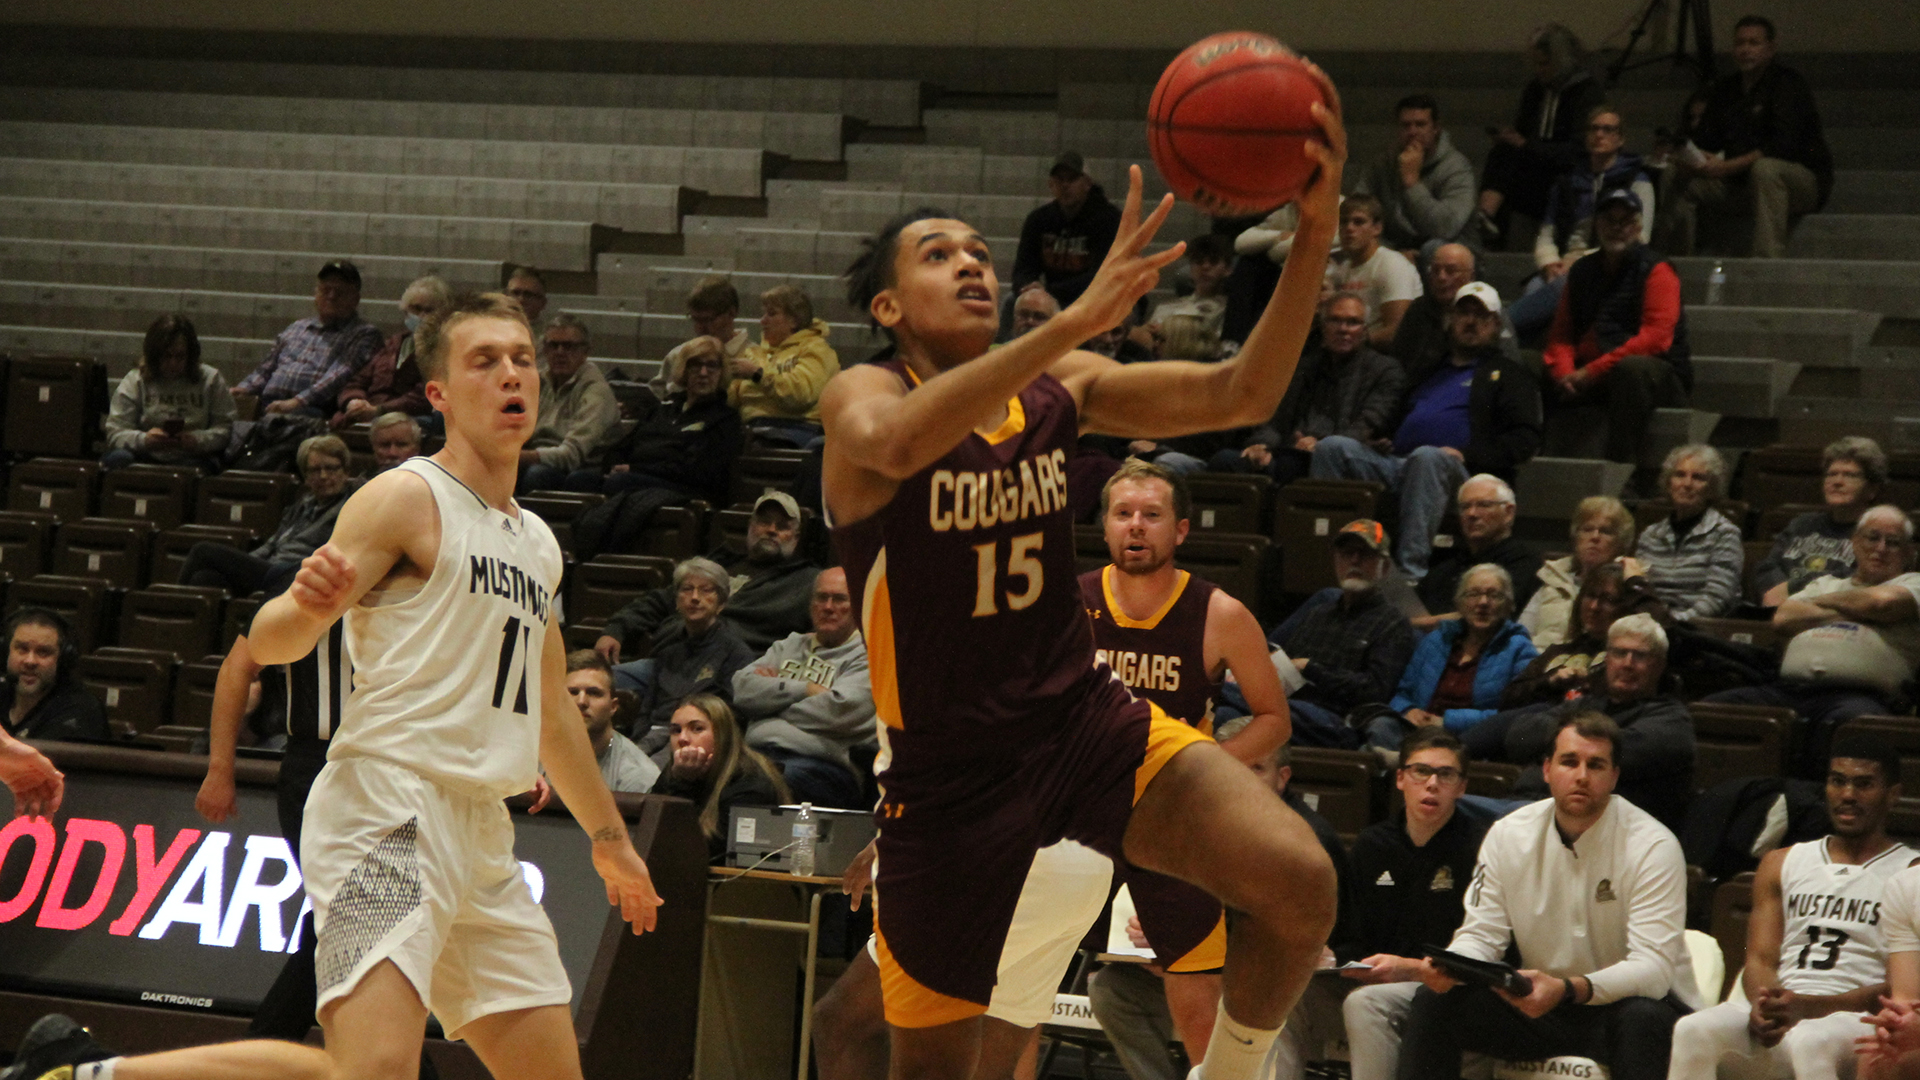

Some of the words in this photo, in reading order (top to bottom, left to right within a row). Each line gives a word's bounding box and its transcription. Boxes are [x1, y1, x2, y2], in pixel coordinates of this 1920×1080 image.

[929, 448, 1067, 532] COUGARS
[971, 531, 1044, 618] 15
[491, 615, 531, 716] 11
[1093, 648, 1182, 692] UGARS
[1787, 893, 1882, 926] MUSTANGS
[1797, 925, 1851, 970] 13
[141, 991, 213, 1008] DAKTRONICS
[1050, 1001, 1092, 1019] STAN
